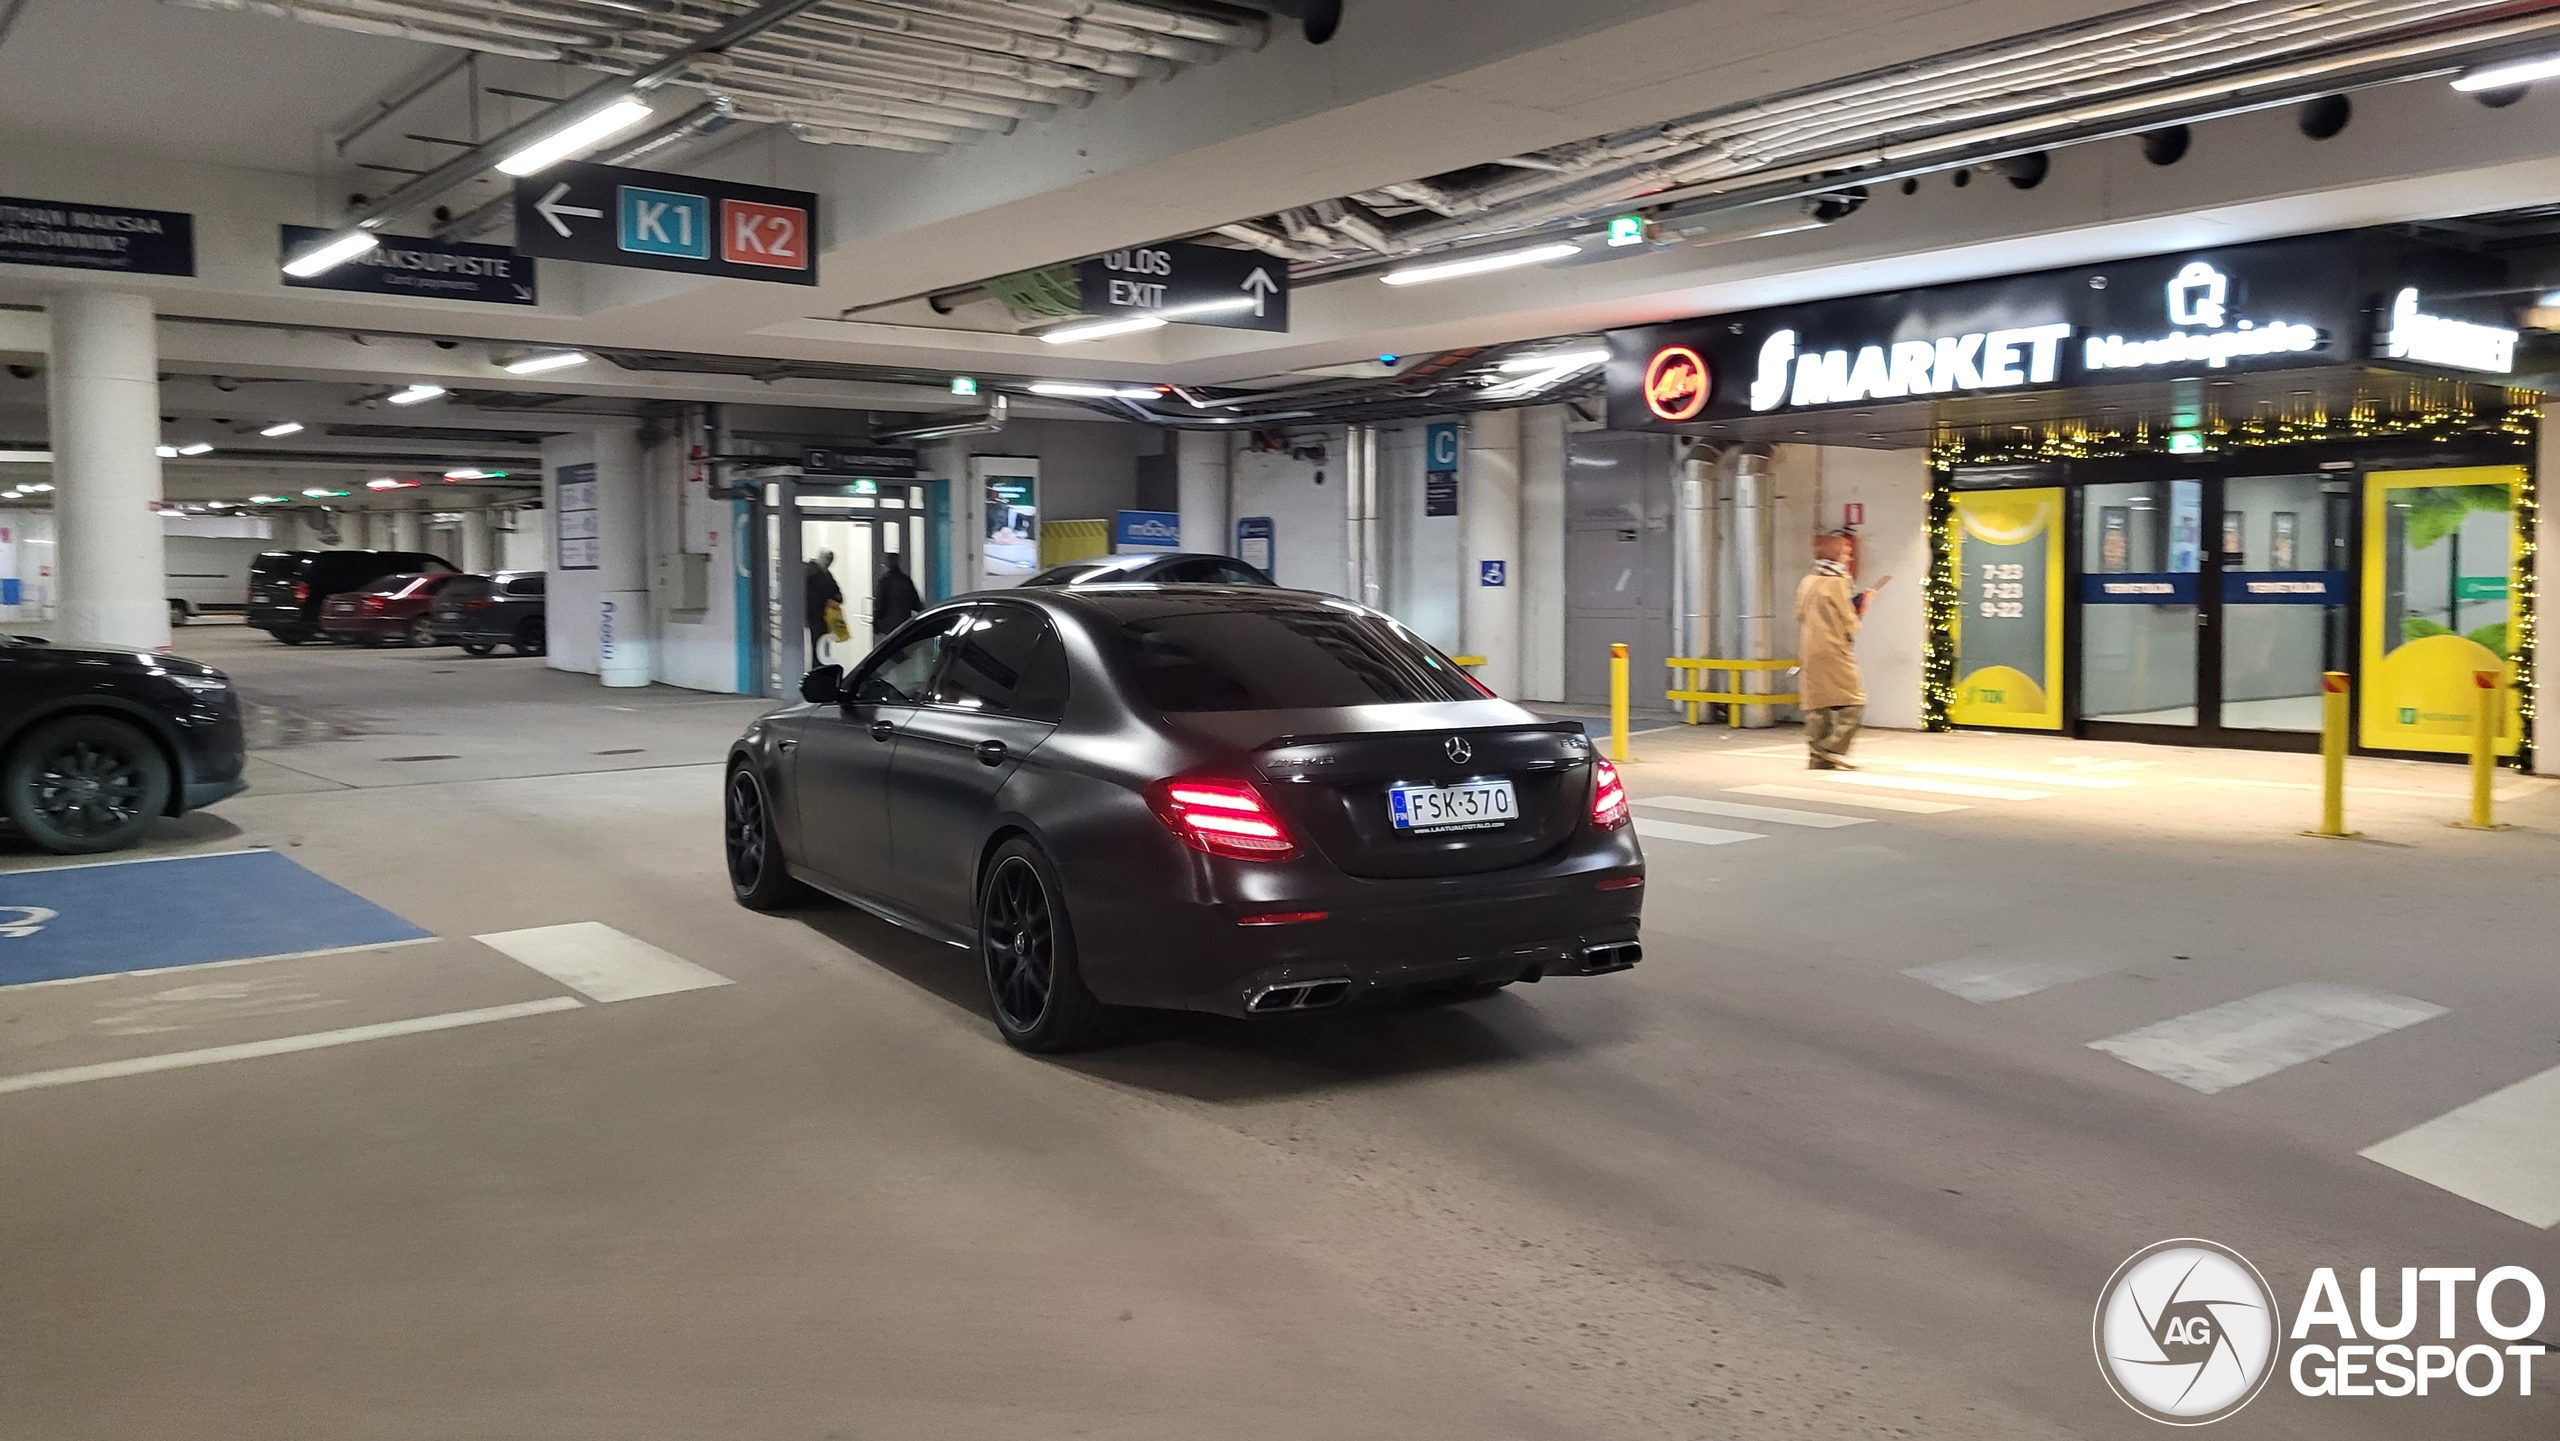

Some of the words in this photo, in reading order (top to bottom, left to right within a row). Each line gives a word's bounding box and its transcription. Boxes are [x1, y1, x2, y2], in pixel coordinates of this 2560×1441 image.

[636, 199, 693, 246] K1
[734, 211, 796, 257] K2
[1109, 278, 1167, 309] EXIT
[1791, 322, 2071, 406] MARKET
[1435, 430, 1455, 463] C
[1981, 564, 2024, 580] 7-23
[1981, 583, 2024, 599] 7-23
[1980, 602, 2024, 618] 9-22
[1396, 812, 1408, 821] FIN
